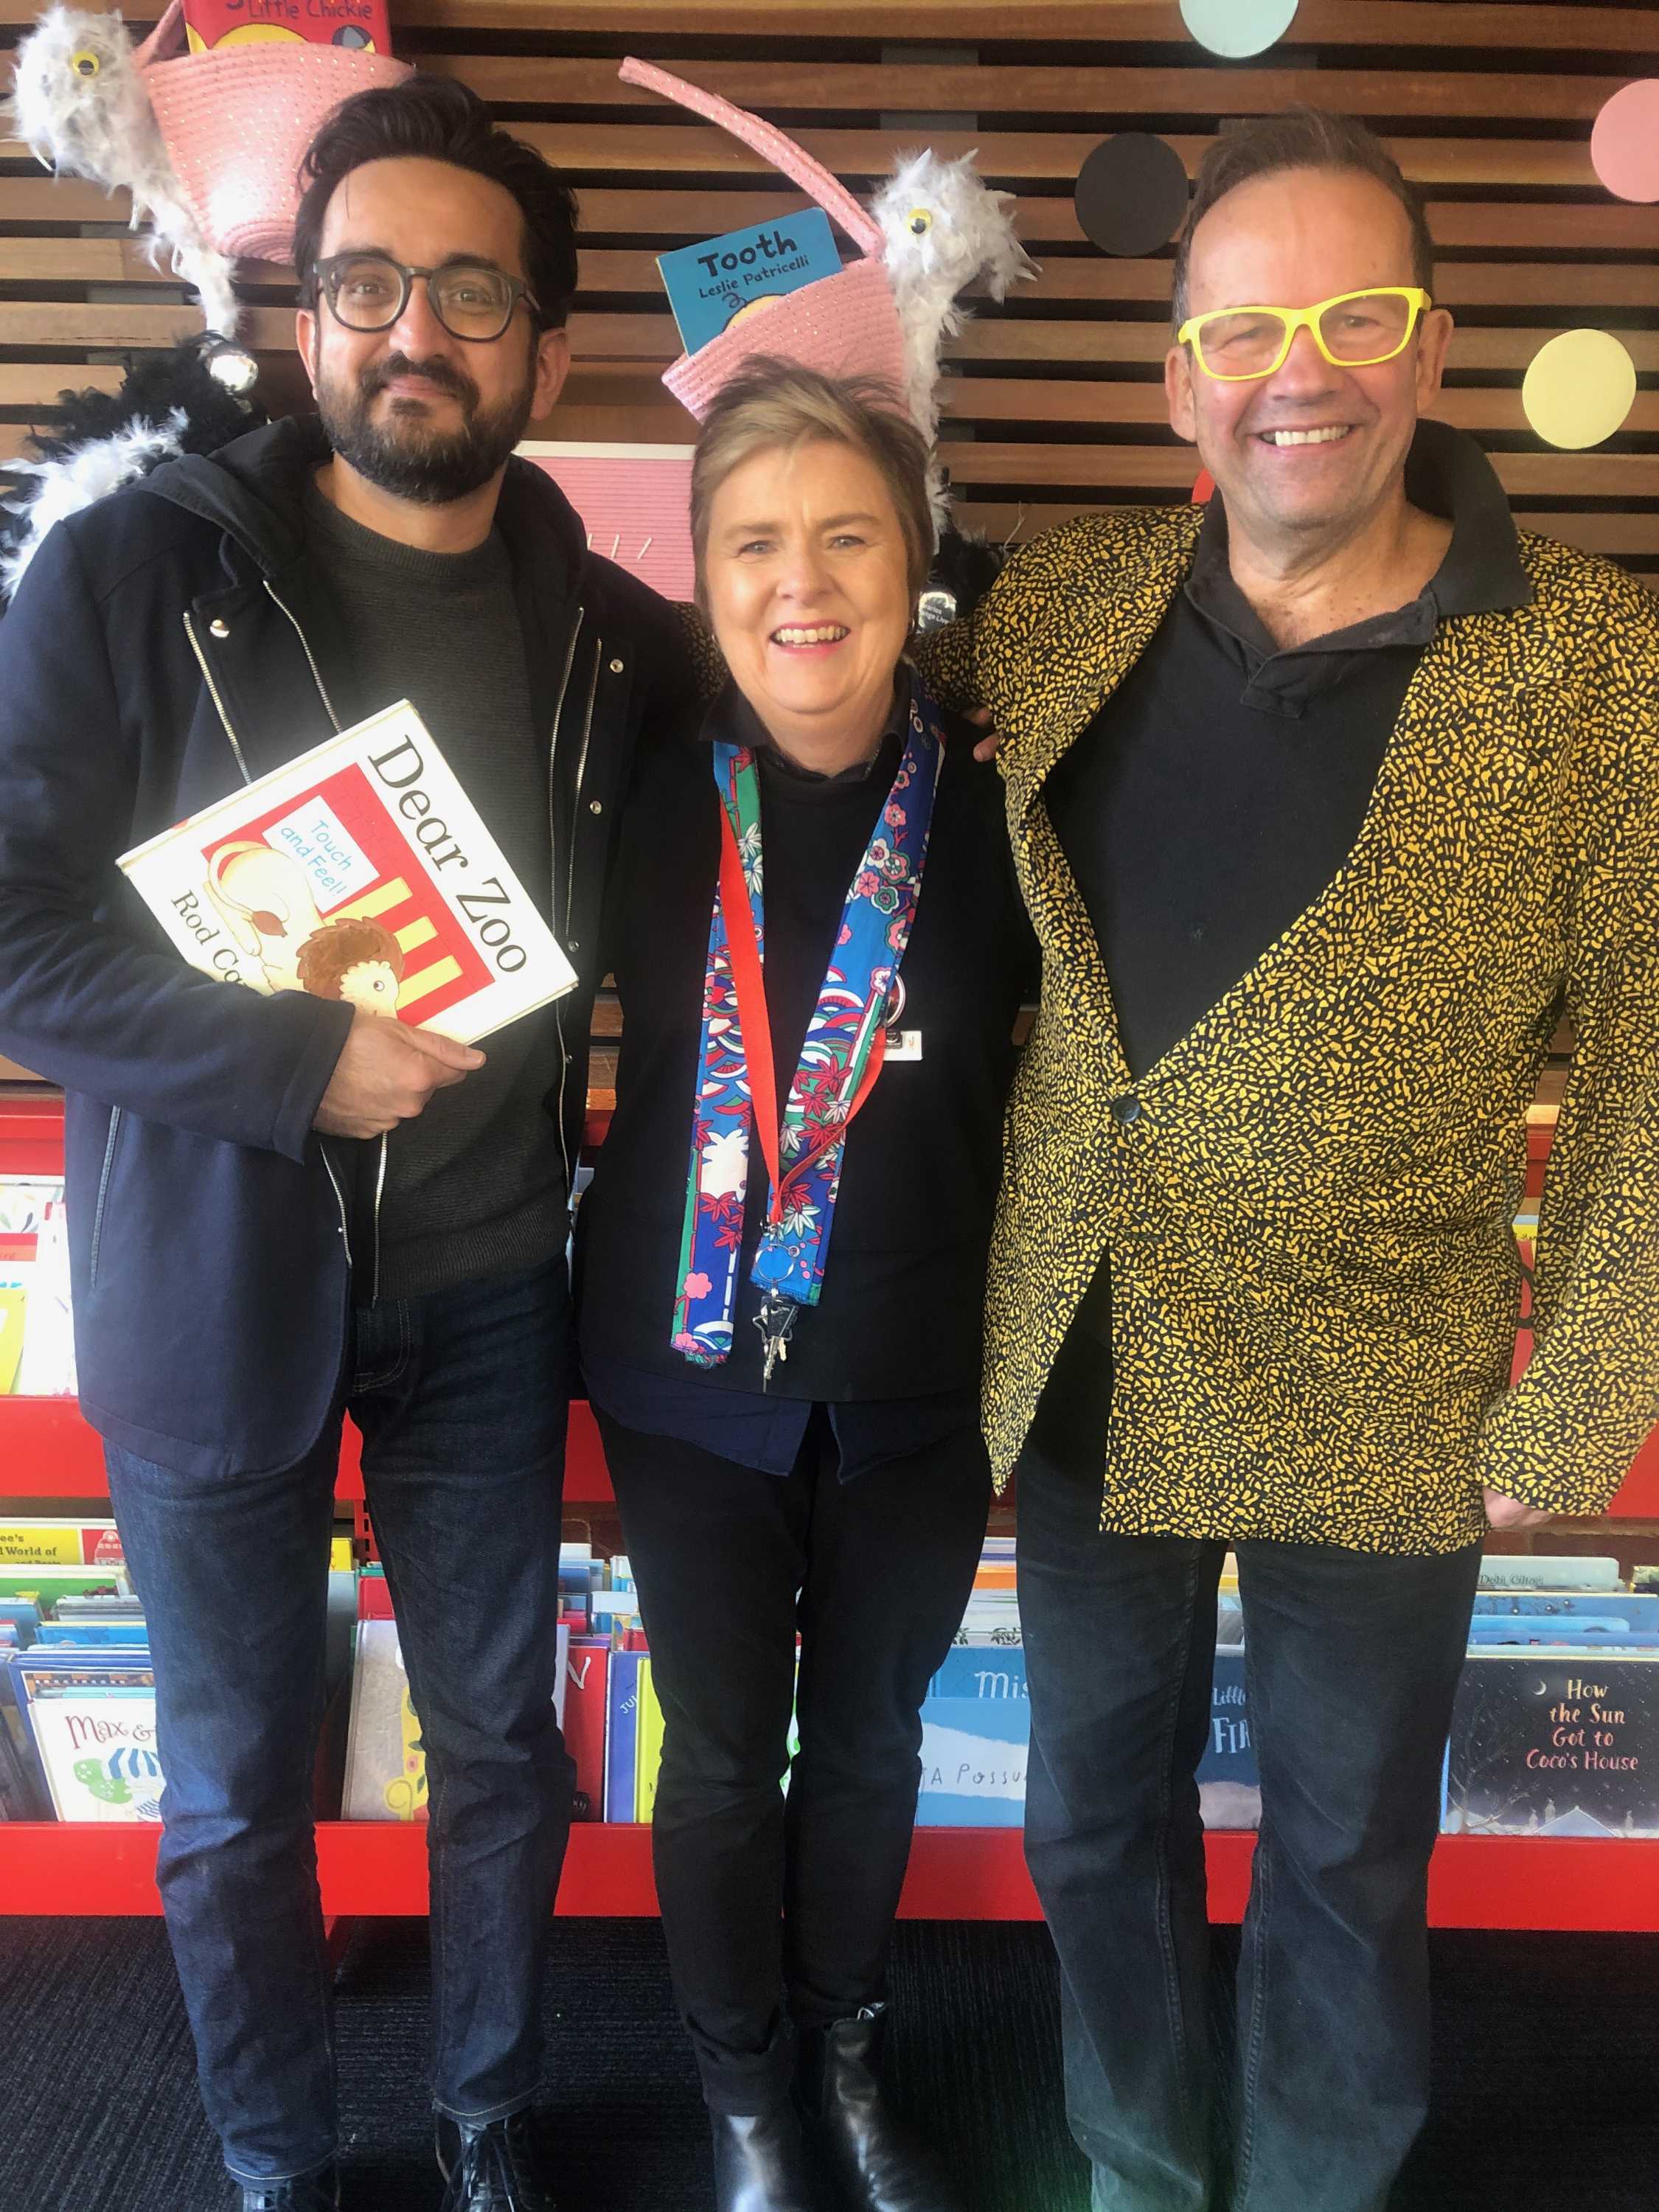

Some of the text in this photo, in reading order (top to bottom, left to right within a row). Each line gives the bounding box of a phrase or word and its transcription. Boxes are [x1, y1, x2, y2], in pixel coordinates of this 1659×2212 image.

[248, 1, 299, 19] Little
[307, 0, 372, 19] Chickie
[698, 230, 798, 277] Tooth
[698, 254, 810, 299] Leslie Patricelli
[281, 827, 315, 858] and
[310, 819, 352, 872] Touch
[367, 734, 527, 973] Dear Zoo
[170, 888, 220, 946] Rod
[5, 1546, 42, 1556] World
[45, 1547, 58, 1556] of
[1567, 1678, 1610, 1700] How
[1549, 1702, 1626, 1725] the Sun
[65, 1715, 129, 1750] Max
[1552, 1727, 1614, 1747] Got to
[1526, 1748, 1639, 1770] Coco's House
[956, 1762, 1027, 1786] Possu
